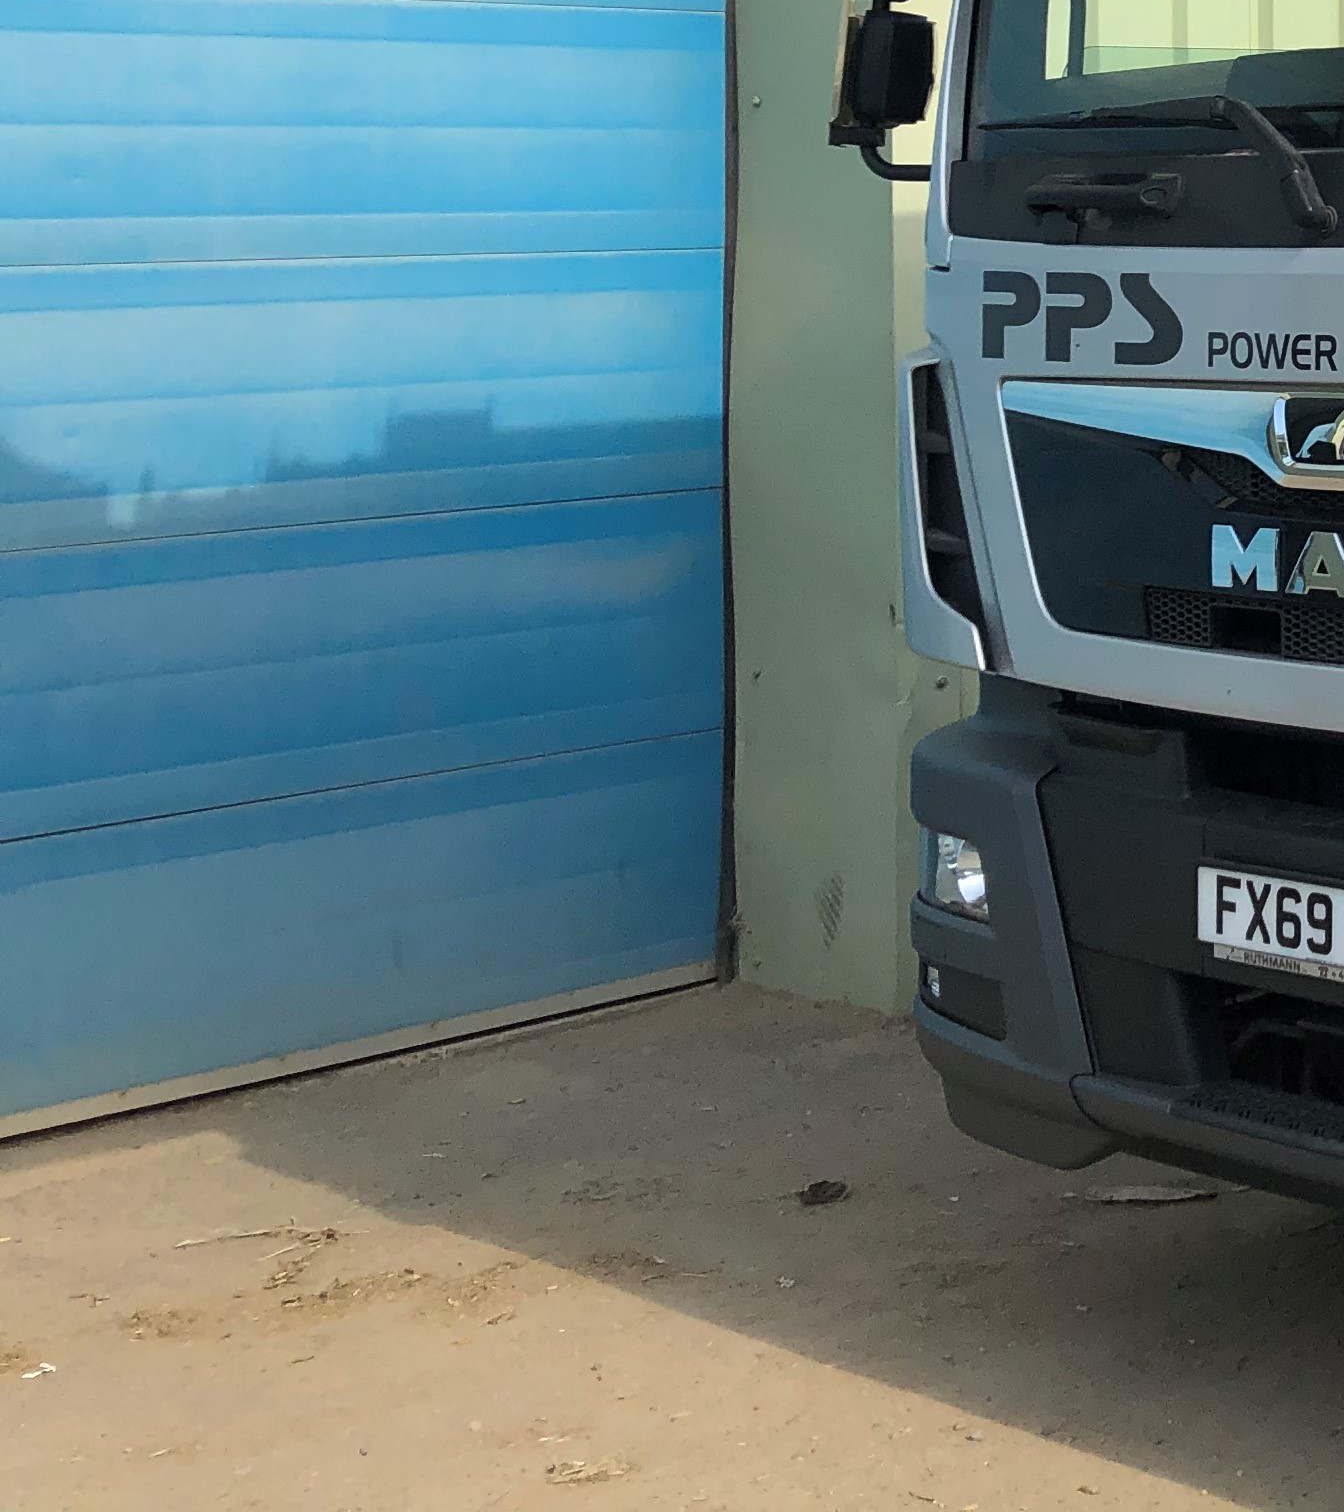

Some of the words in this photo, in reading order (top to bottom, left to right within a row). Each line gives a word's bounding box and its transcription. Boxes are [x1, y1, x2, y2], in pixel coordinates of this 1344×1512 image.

[981, 270, 1184, 366] PPS
[1207, 331, 1338, 372] POWER
[1215, 874, 1333, 956] FX69
[1243, 951, 1302, 973] RUTHMANN
